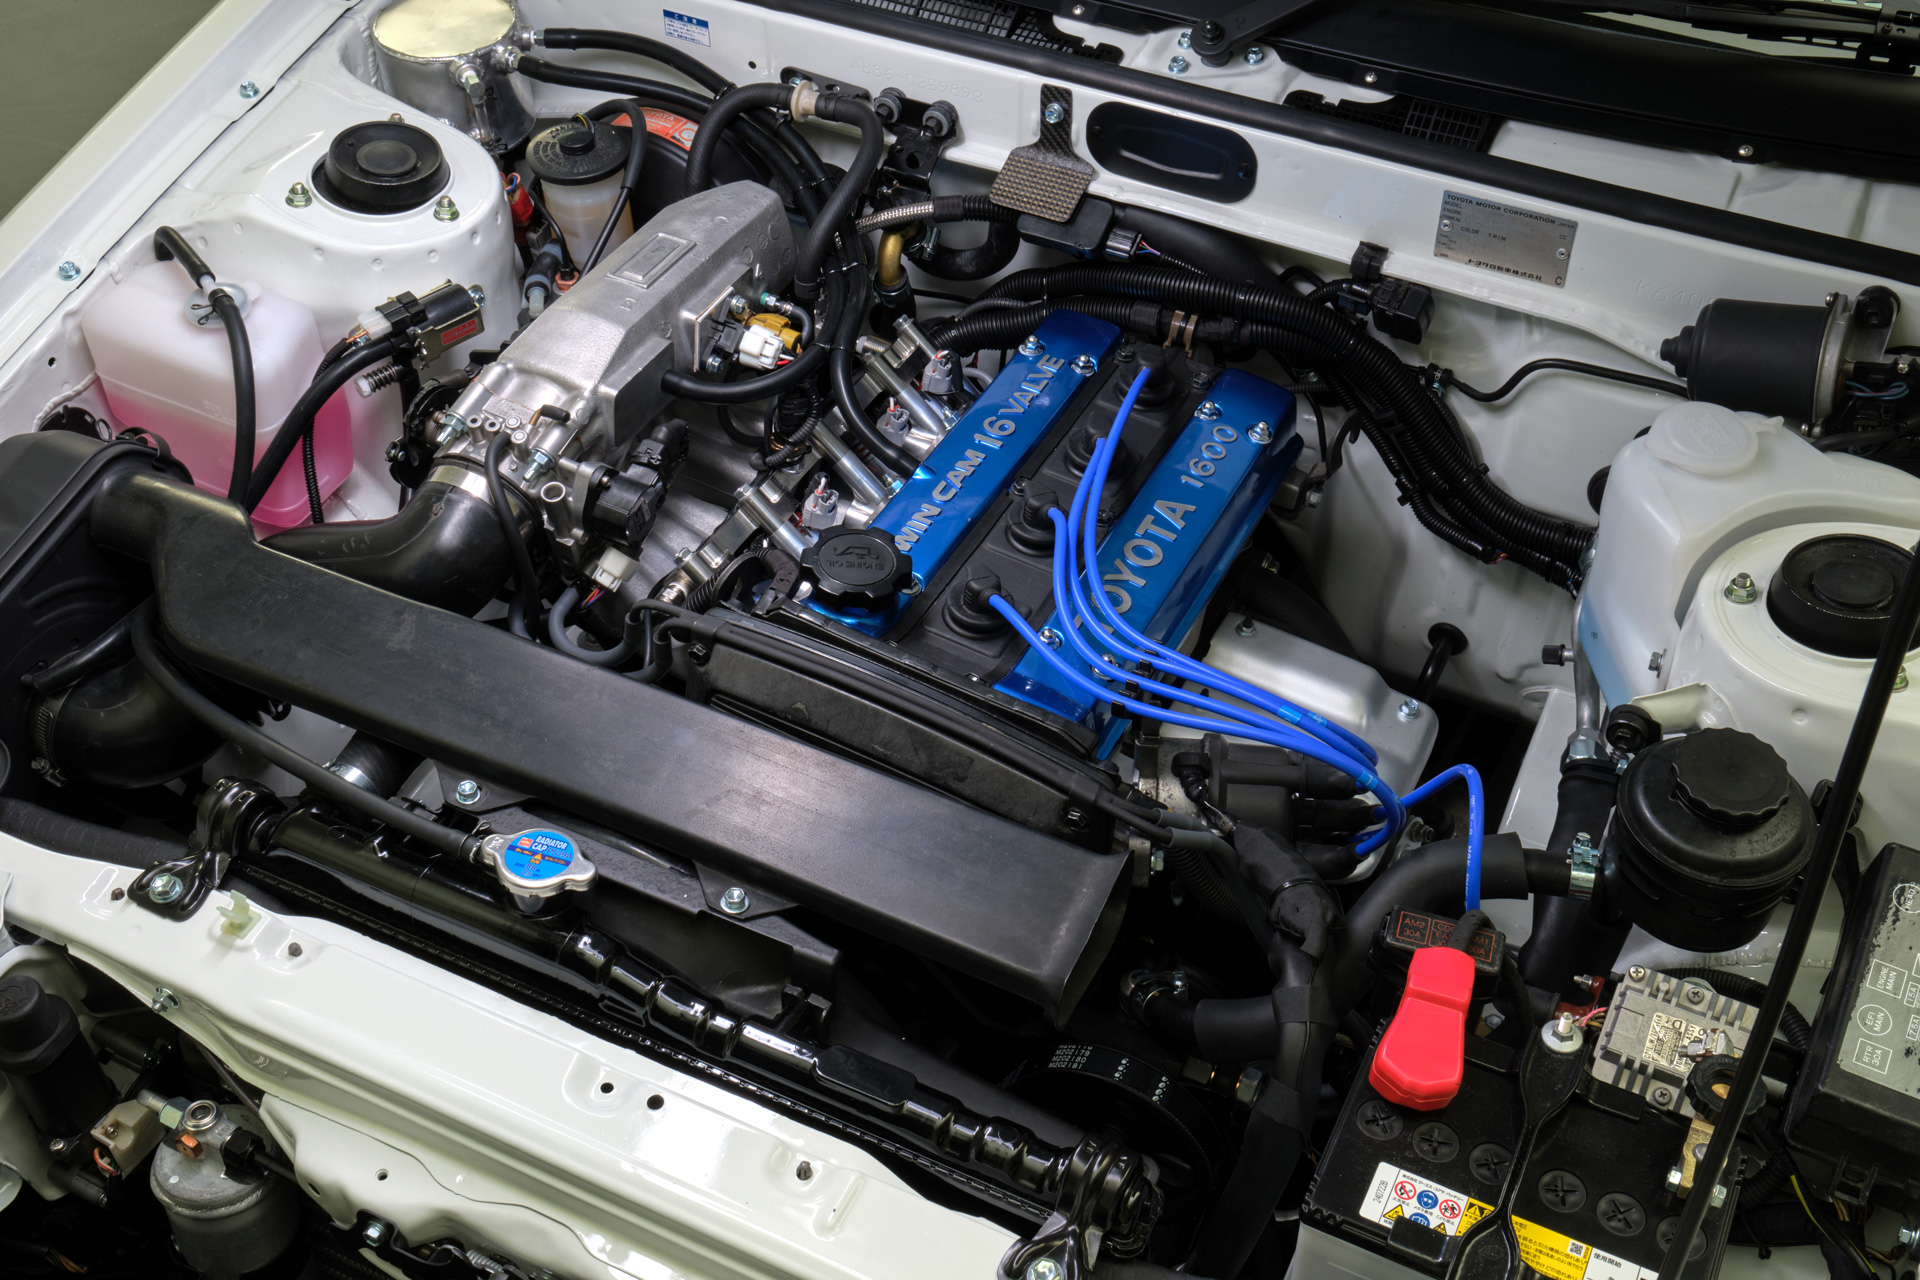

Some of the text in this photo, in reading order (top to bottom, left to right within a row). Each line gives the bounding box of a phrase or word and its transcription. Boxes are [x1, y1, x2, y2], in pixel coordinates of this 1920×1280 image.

[1444, 200, 1463, 209] MODEL
[1446, 194, 1473, 205] TOYOTA
[1475, 200, 1502, 212] MOTOR
[1503, 207, 1556, 225] CORPORATION
[1460, 226, 1507, 242] COLOR TRIM
[1554, 276, 1563, 286] C
[895, 354, 1065, 553] WIN CAM 16 VALVE
[1181, 425, 1238, 488] 1600
[531, 843, 547, 852] CAP
[535, 836, 568, 850] RADIATOR
[1904, 888, 1916, 910] HEAD
[1404, 917, 1425, 929] AM2
[1403, 928, 1421, 938] 30A
[1473, 935, 1489, 945] M1
[1876, 966, 1890, 990] ENGINE
[1886, 970, 1898, 991] MAIN
[1907, 986, 1917, 1003] 15A
[1866, 1011, 1875, 1026] EFI
[1874, 1011, 1885, 1033] MAIN
[1862, 1045, 1874, 1064] RTR
[1872, 1048, 1883, 1067] 30A
[1593, 1252, 1622, 1269] 使用開始
